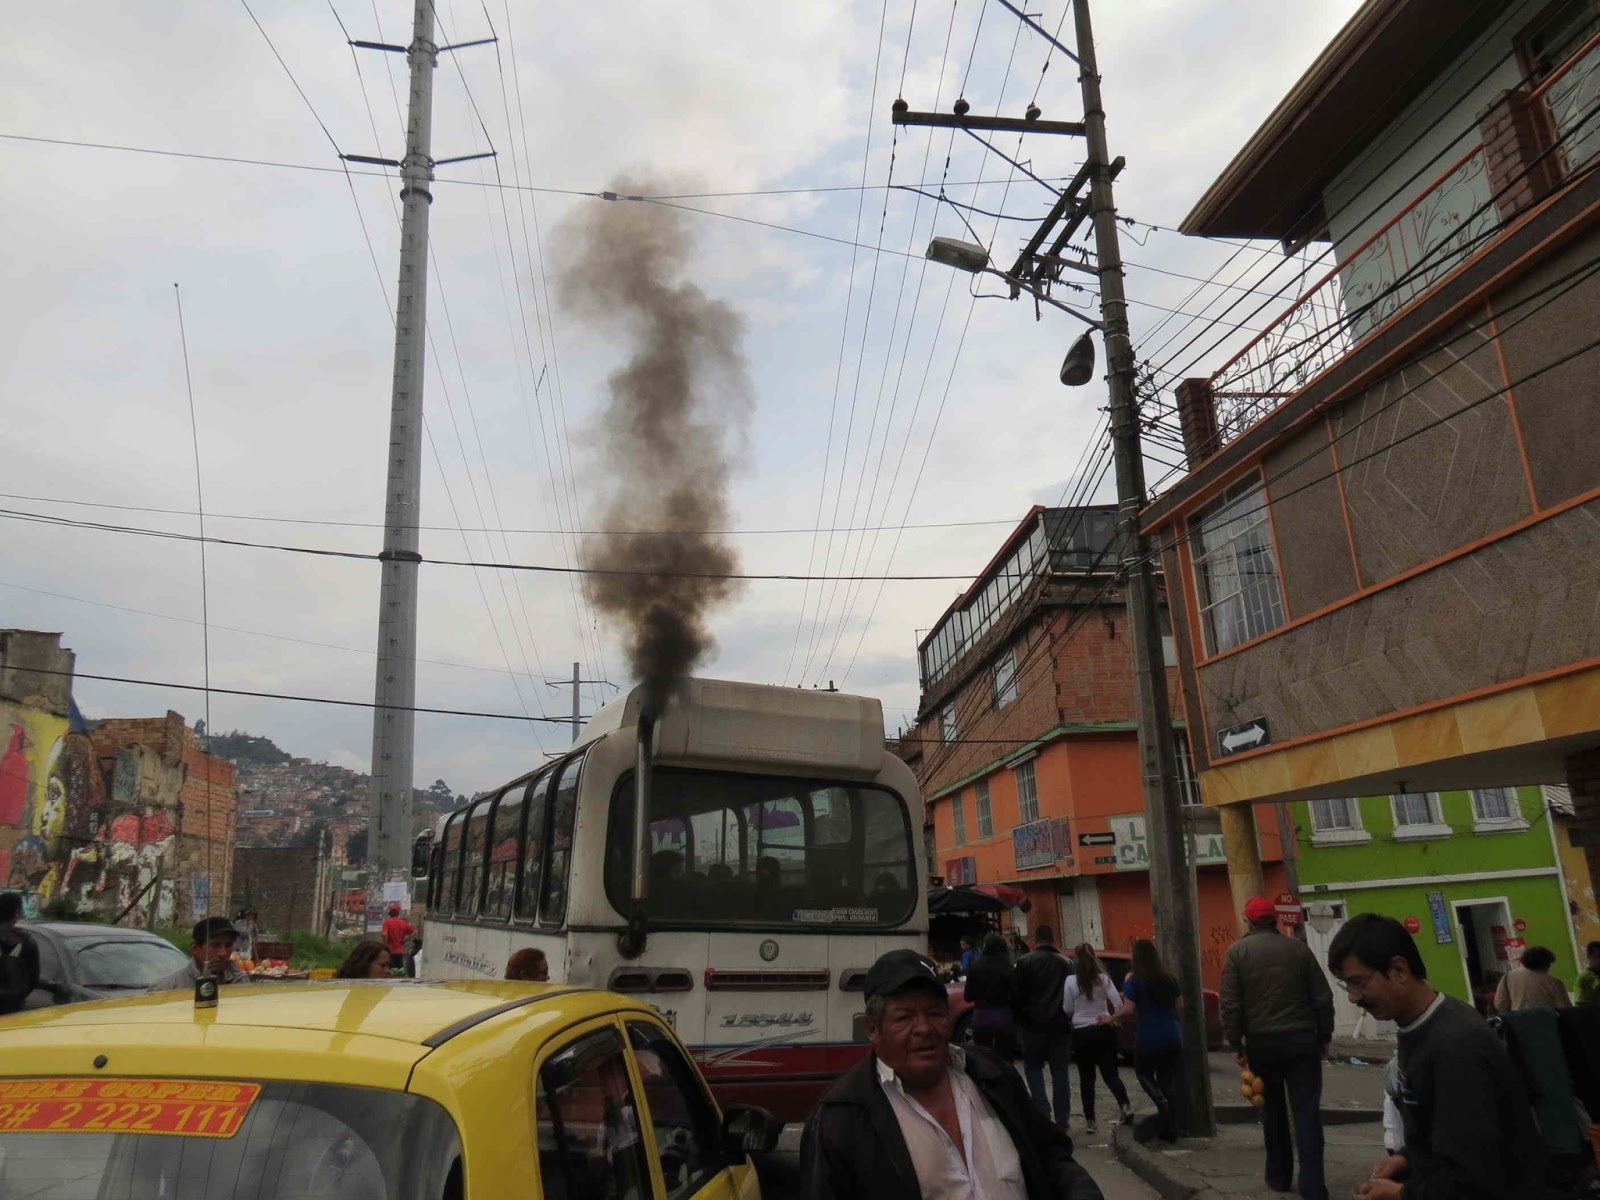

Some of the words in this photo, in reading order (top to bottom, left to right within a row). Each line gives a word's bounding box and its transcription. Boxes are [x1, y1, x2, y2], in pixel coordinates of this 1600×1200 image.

[1128, 822, 1146, 841] L
[1281, 894, 1293, 903] NO
[1279, 913, 1298, 924] PASE
[47, 1102, 83, 1130] 2
[82, 1102, 163, 1130] 222
[174, 1103, 239, 1134] 111
